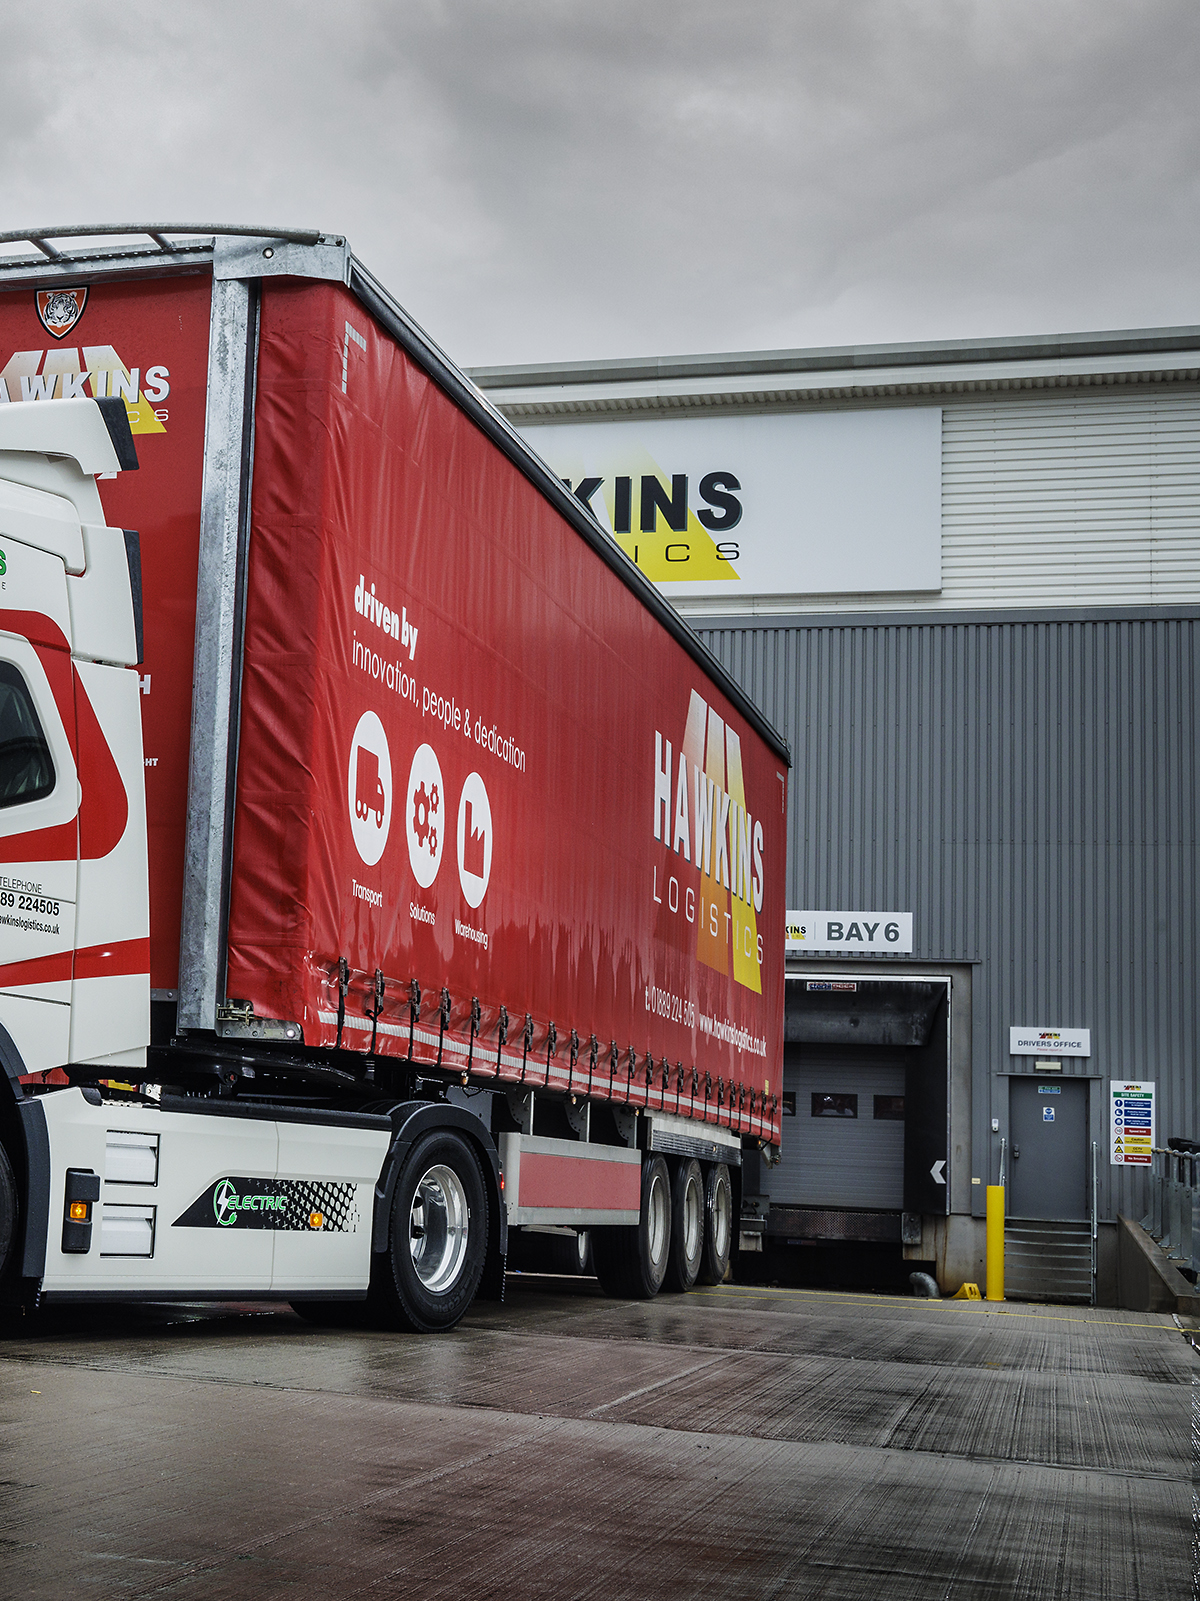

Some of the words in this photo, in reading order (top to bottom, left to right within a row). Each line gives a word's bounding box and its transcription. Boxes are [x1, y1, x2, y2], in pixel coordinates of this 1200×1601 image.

[354, 574, 399, 641] driven
[401, 606, 418, 660] by
[352, 630, 419, 708] innovation,
[422, 686, 461, 730] people
[464, 708, 471, 738] &
[474, 715, 526, 773] dedication
[653, 729, 764, 915] HAWKINS
[18, 895, 59, 916] 224505
[352, 878, 382, 908] Transport
[409, 902, 436, 926] Solutions
[653, 866, 764, 965] LOGISTICS
[454, 918, 489, 950] Warehousing
[827, 922, 880, 942] BAY
[884, 922, 900, 942] 6
[651, 986, 670, 1018] 01889
[671, 995, 682, 1024] 224
[683, 1000, 695, 1029] 505
[227, 1195, 288, 1211] ELECTRIC
